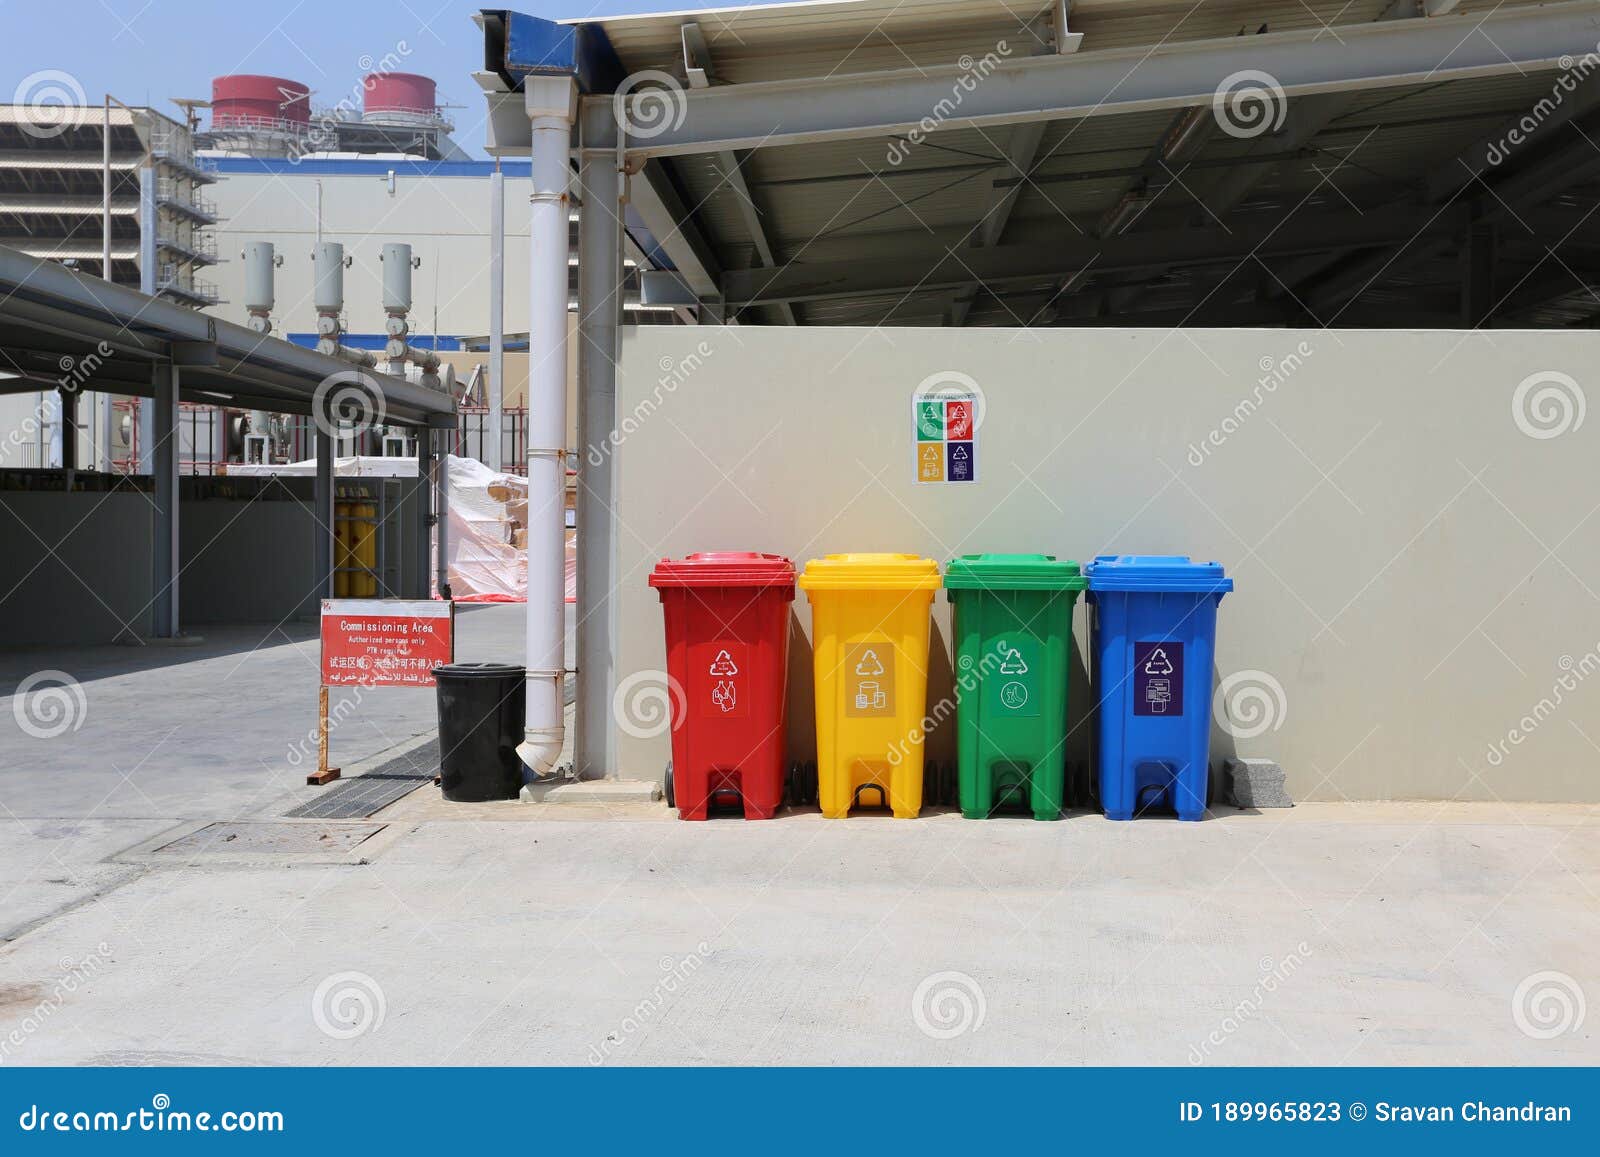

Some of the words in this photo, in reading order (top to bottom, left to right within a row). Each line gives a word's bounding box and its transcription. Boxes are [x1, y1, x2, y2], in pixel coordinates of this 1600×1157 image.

[340, 620, 408, 634] Commissioning
[412, 622, 433, 633] Area
[411, 637, 425, 646] only
